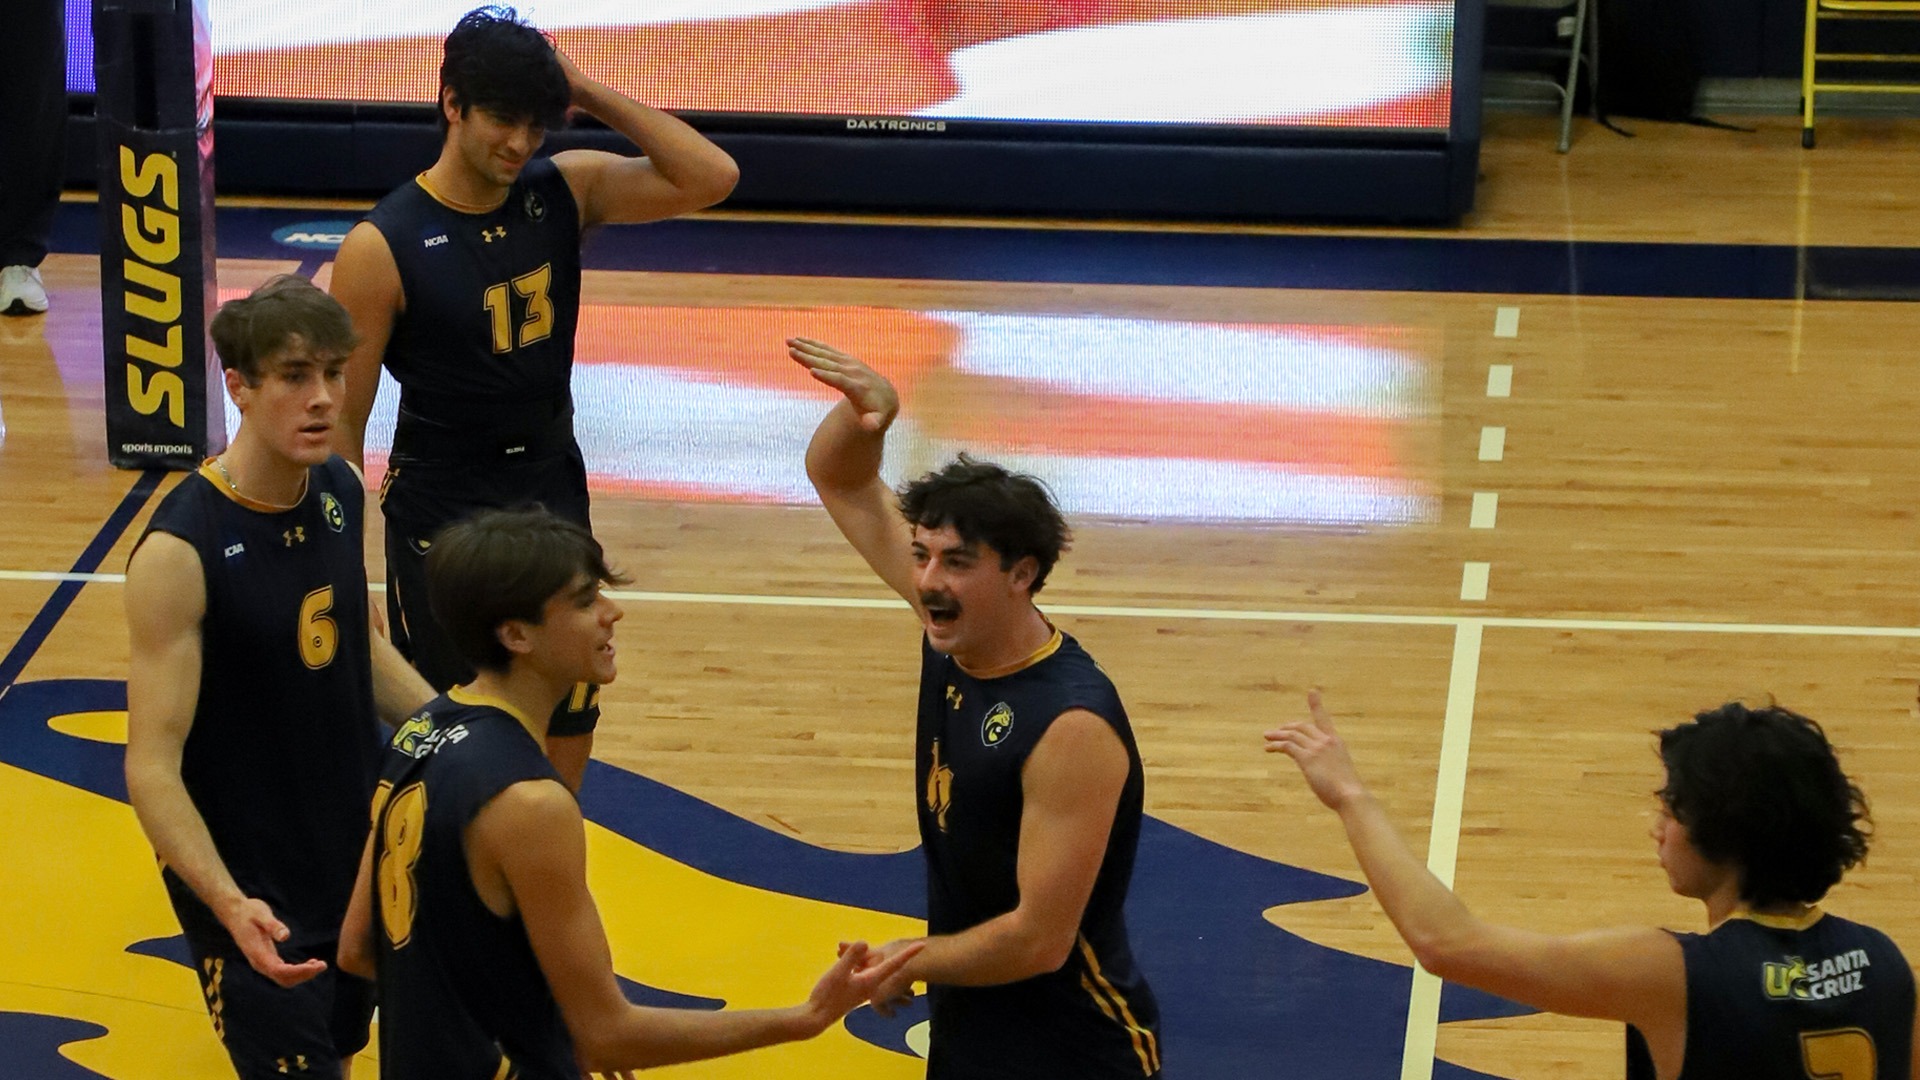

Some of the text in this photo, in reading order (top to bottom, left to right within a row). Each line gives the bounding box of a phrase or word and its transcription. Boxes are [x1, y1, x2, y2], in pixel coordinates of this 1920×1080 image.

[846, 119, 946, 131] DAKTRONICS
[283, 232, 347, 243] NC
[424, 234, 449, 248] NCAA
[119, 144, 186, 429] SLUGS
[483, 262, 555, 354] 13
[121, 442, 193, 455] sports imports
[297, 584, 339, 670] 6
[1807, 949, 1871, 982] SANTA
[1810, 971, 1865, 1000] CRUZ
